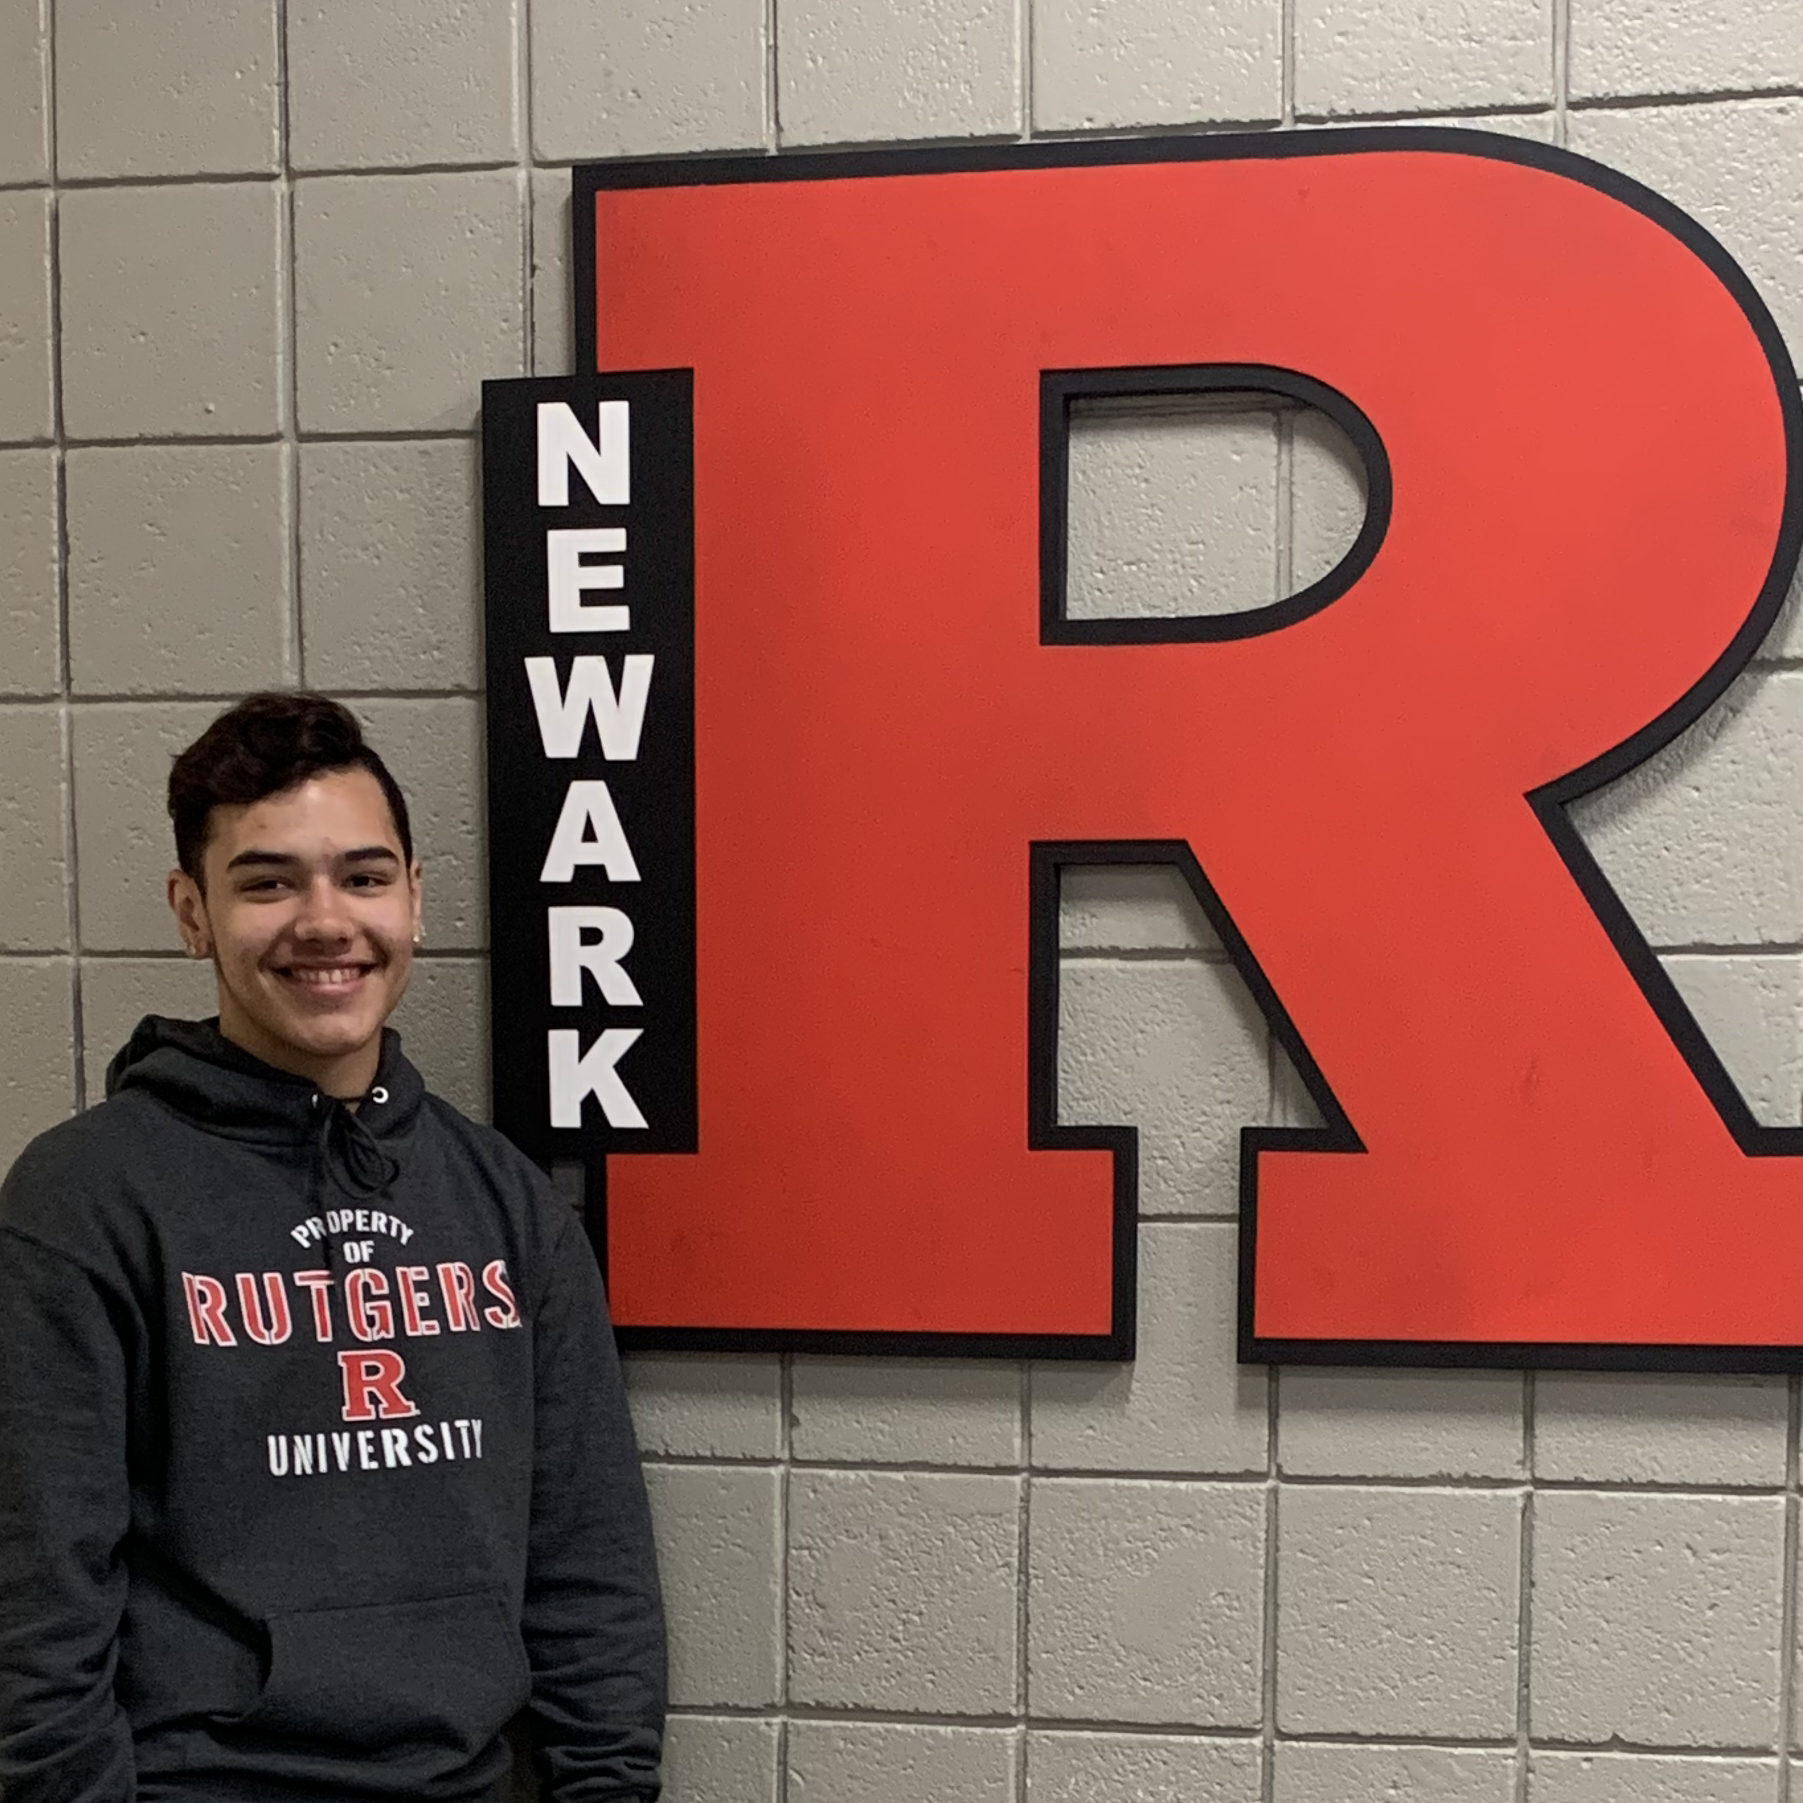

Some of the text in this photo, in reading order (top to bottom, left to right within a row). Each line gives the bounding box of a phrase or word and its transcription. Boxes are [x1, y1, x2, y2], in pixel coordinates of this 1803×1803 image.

[524, 400, 655, 1130] NEWARK
[573, 125, 1803, 1370] R
[290, 1209, 414, 1249] PROPERTY
[343, 1240, 375, 1264] OF
[181, 1259, 523, 1347] RUTGERS
[337, 1348, 421, 1422] R
[267, 1418, 483, 1476] UNIVERSITY
